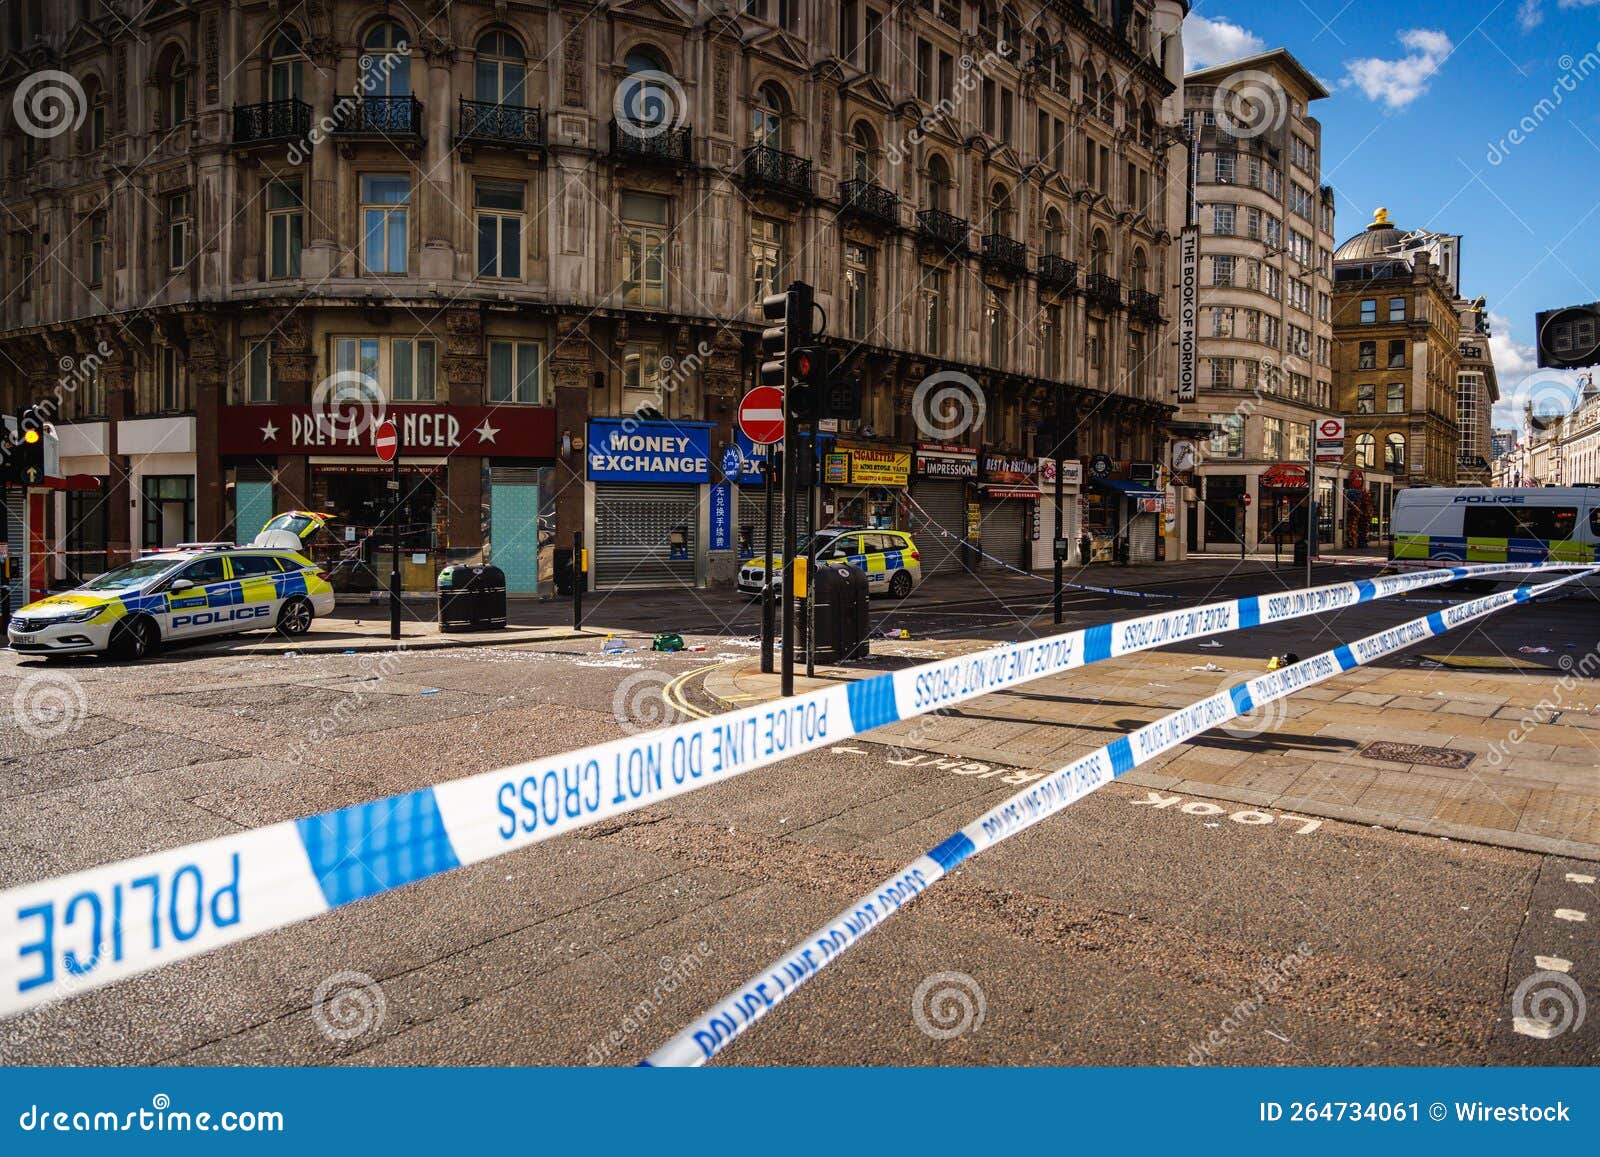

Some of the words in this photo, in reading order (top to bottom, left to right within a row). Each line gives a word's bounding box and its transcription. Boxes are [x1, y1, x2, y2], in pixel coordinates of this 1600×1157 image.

[1184, 236, 1196, 264] THE
[1183, 267, 1195, 310] BOOK
[1183, 312, 1194, 328] OF
[1182, 331, 1194, 393] MORMON
[291, 413, 339, 446] PRET
[347, 413, 360, 446] A
[610, 435, 690, 453] MONEY
[592, 455, 707, 473] EXCHANGE
[853, 450, 896, 462] CIGARETTES
[927, 463, 973, 475] IMPRESSION
[986, 458, 1002, 471] BEST
[1454, 495, 1525, 504] POLICE
[172, 605, 271, 628] POLICE
[1152, 618, 1171, 642] NOT
[1171, 615, 1184, 638] DO
[1184, 611, 1203, 636] LINE
[1203, 606, 1232, 631] POLICE
[1122, 621, 1153, 650] CROSS
[989, 654, 1007, 685] DO
[1008, 647, 1034, 680] LINE
[1034, 638, 1074, 672] POLICE
[915, 665, 960, 707] CROSS
[961, 660, 986, 694] NOT
[764, 697, 829, 755] POLICE
[672, 731, 702, 785] DO
[712, 717, 760, 773] LINE
[612, 742, 662, 804] NOT
[886, 753, 1047, 785] RIGHT
[498, 759, 600, 840] CROSS
[1130, 792, 1324, 835] LOOK
[17, 851, 241, 993] POLICE
